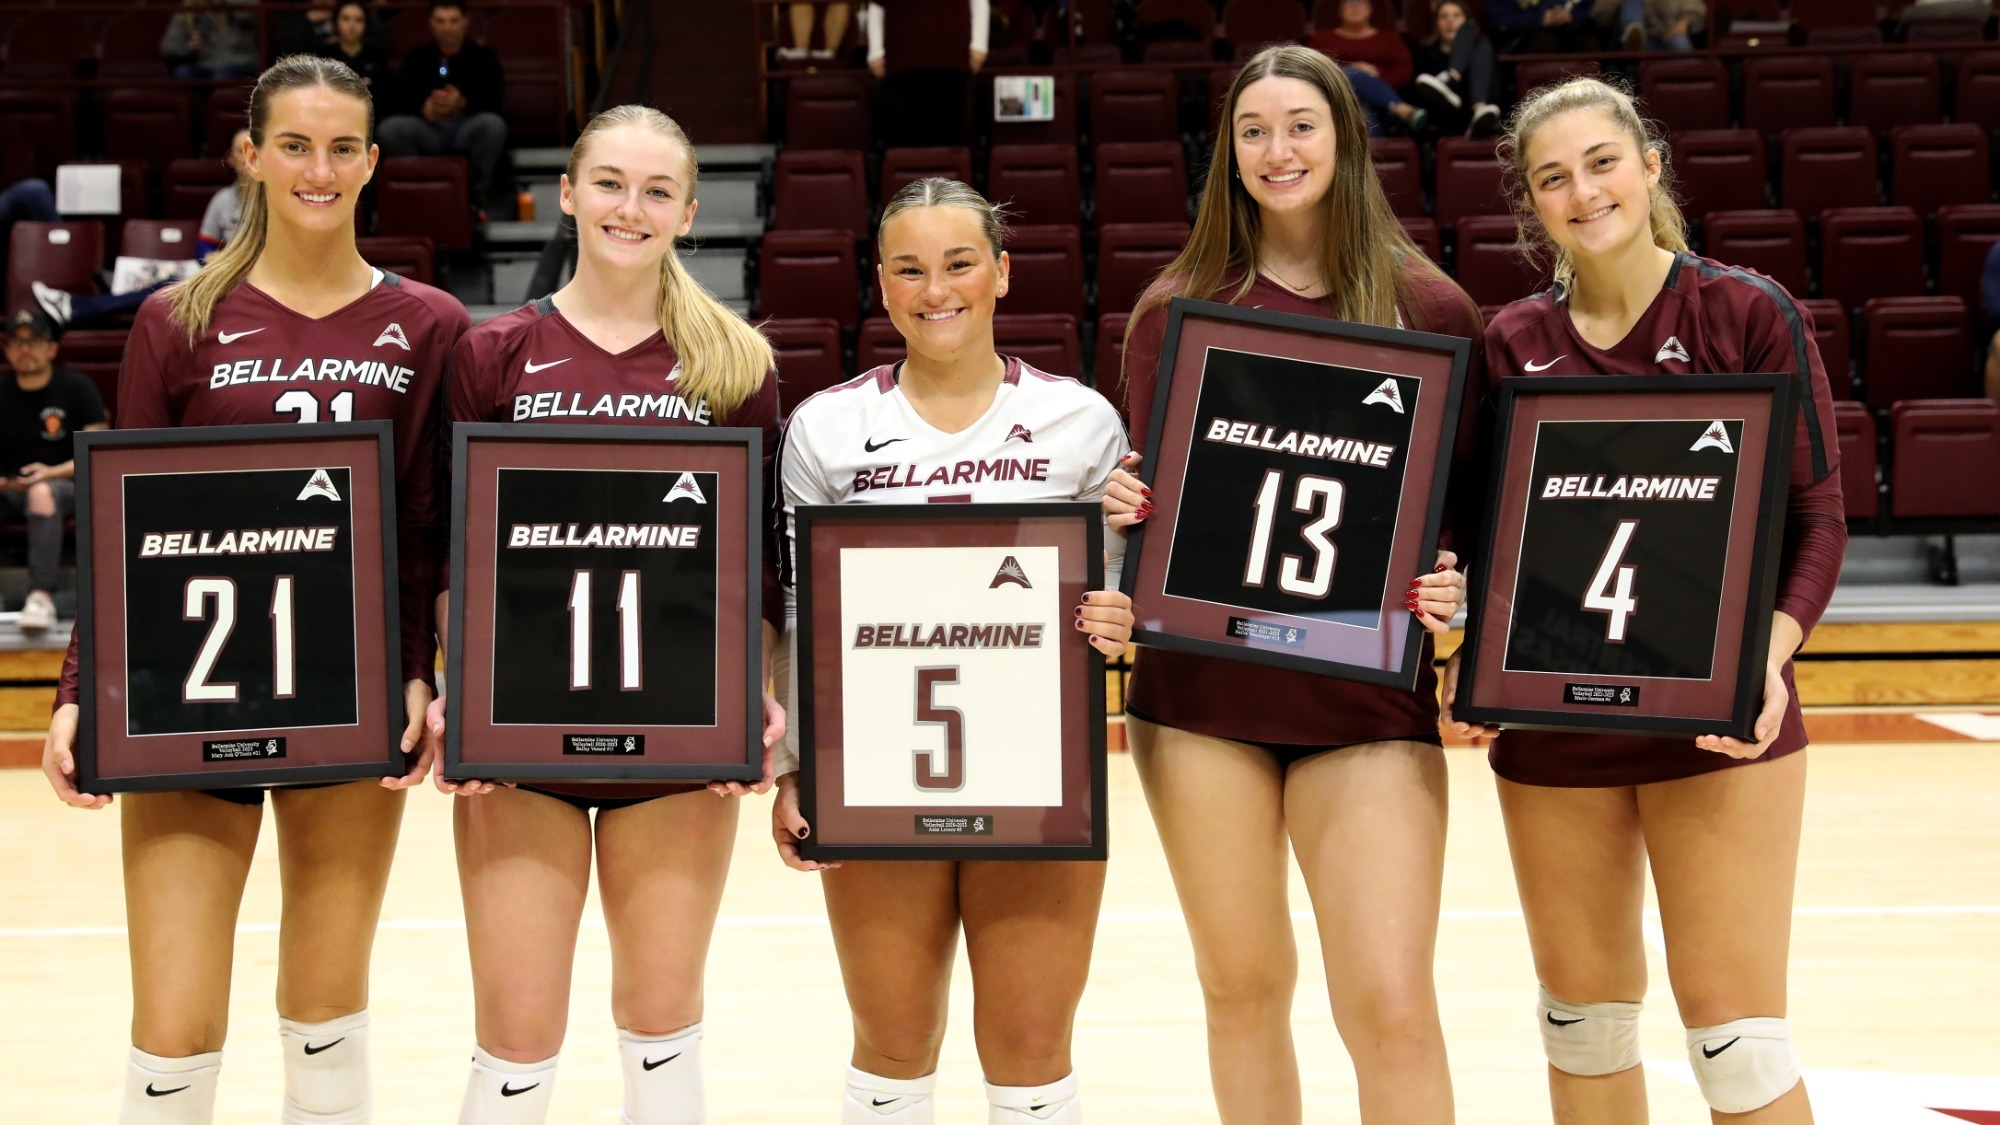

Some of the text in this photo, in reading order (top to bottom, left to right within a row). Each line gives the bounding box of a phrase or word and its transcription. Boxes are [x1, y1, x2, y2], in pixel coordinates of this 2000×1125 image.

[209, 358, 415, 394] BELLARMINE
[1204, 417, 1397, 468] BELLARMINE
[852, 458, 1050, 493] BELLARMINE
[1539, 474, 1722, 501] BELLARMINE
[138, 526, 338, 558] BELLARMINE
[507, 523, 702, 548] BELLARMINE
[1241, 468, 1346, 600] 13
[1580, 519, 1640, 644] 4
[182, 574, 296, 704] 21
[567, 569, 643, 691] 11
[852, 622, 1046, 650] BELLARMINE
[912, 664, 966, 793] 5
